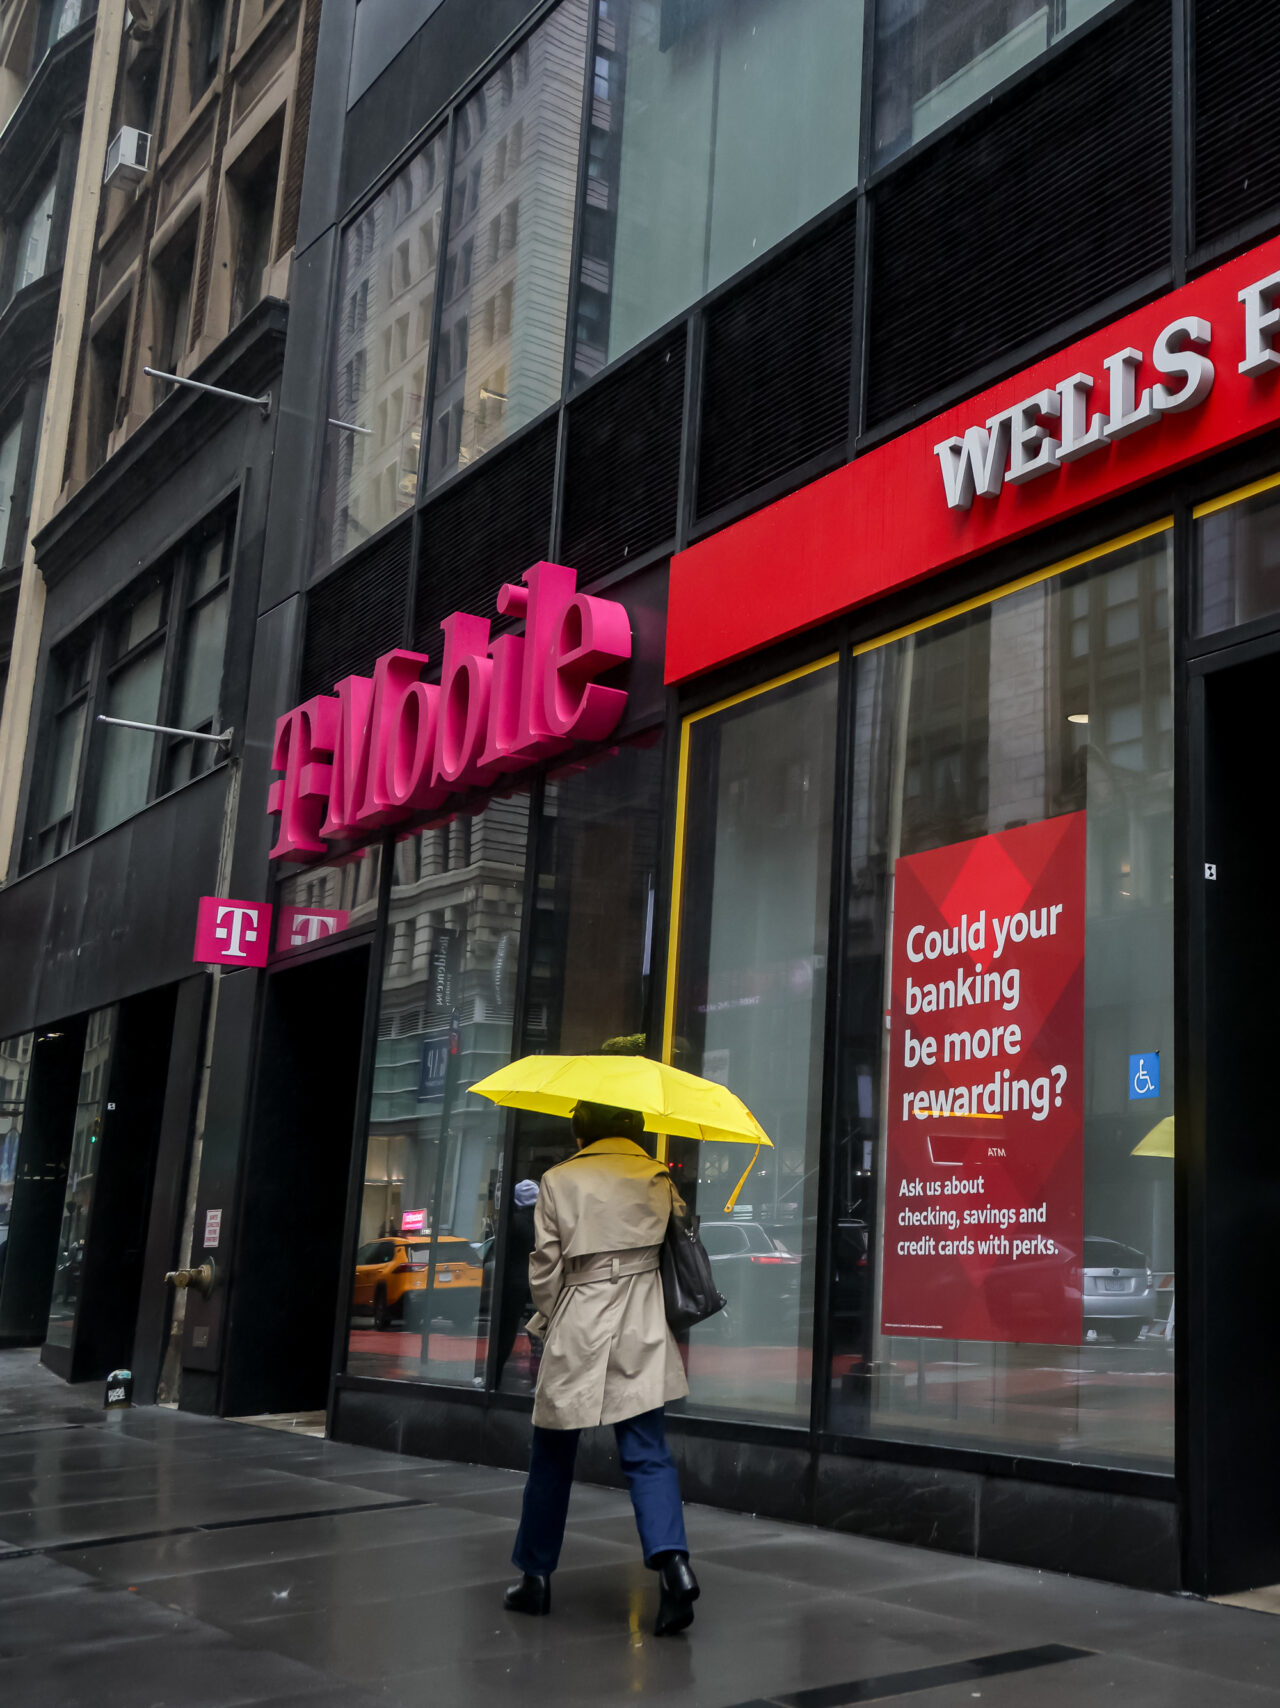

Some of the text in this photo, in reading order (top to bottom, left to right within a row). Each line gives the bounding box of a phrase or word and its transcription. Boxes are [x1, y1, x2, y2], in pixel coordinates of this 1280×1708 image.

[933, 316, 1215, 511] WELLS
[906, 902, 1063, 964] Could your
[905, 963, 1021, 1017] banking
[903, 1022, 1022, 1069] be more
[902, 1064, 1068, 1122] rewarding?
[899, 1175, 985, 1197] Ask us about
[898, 1202, 1047, 1230] checking, savings and
[897, 1234, 1059, 1260] credit cards with perks.
